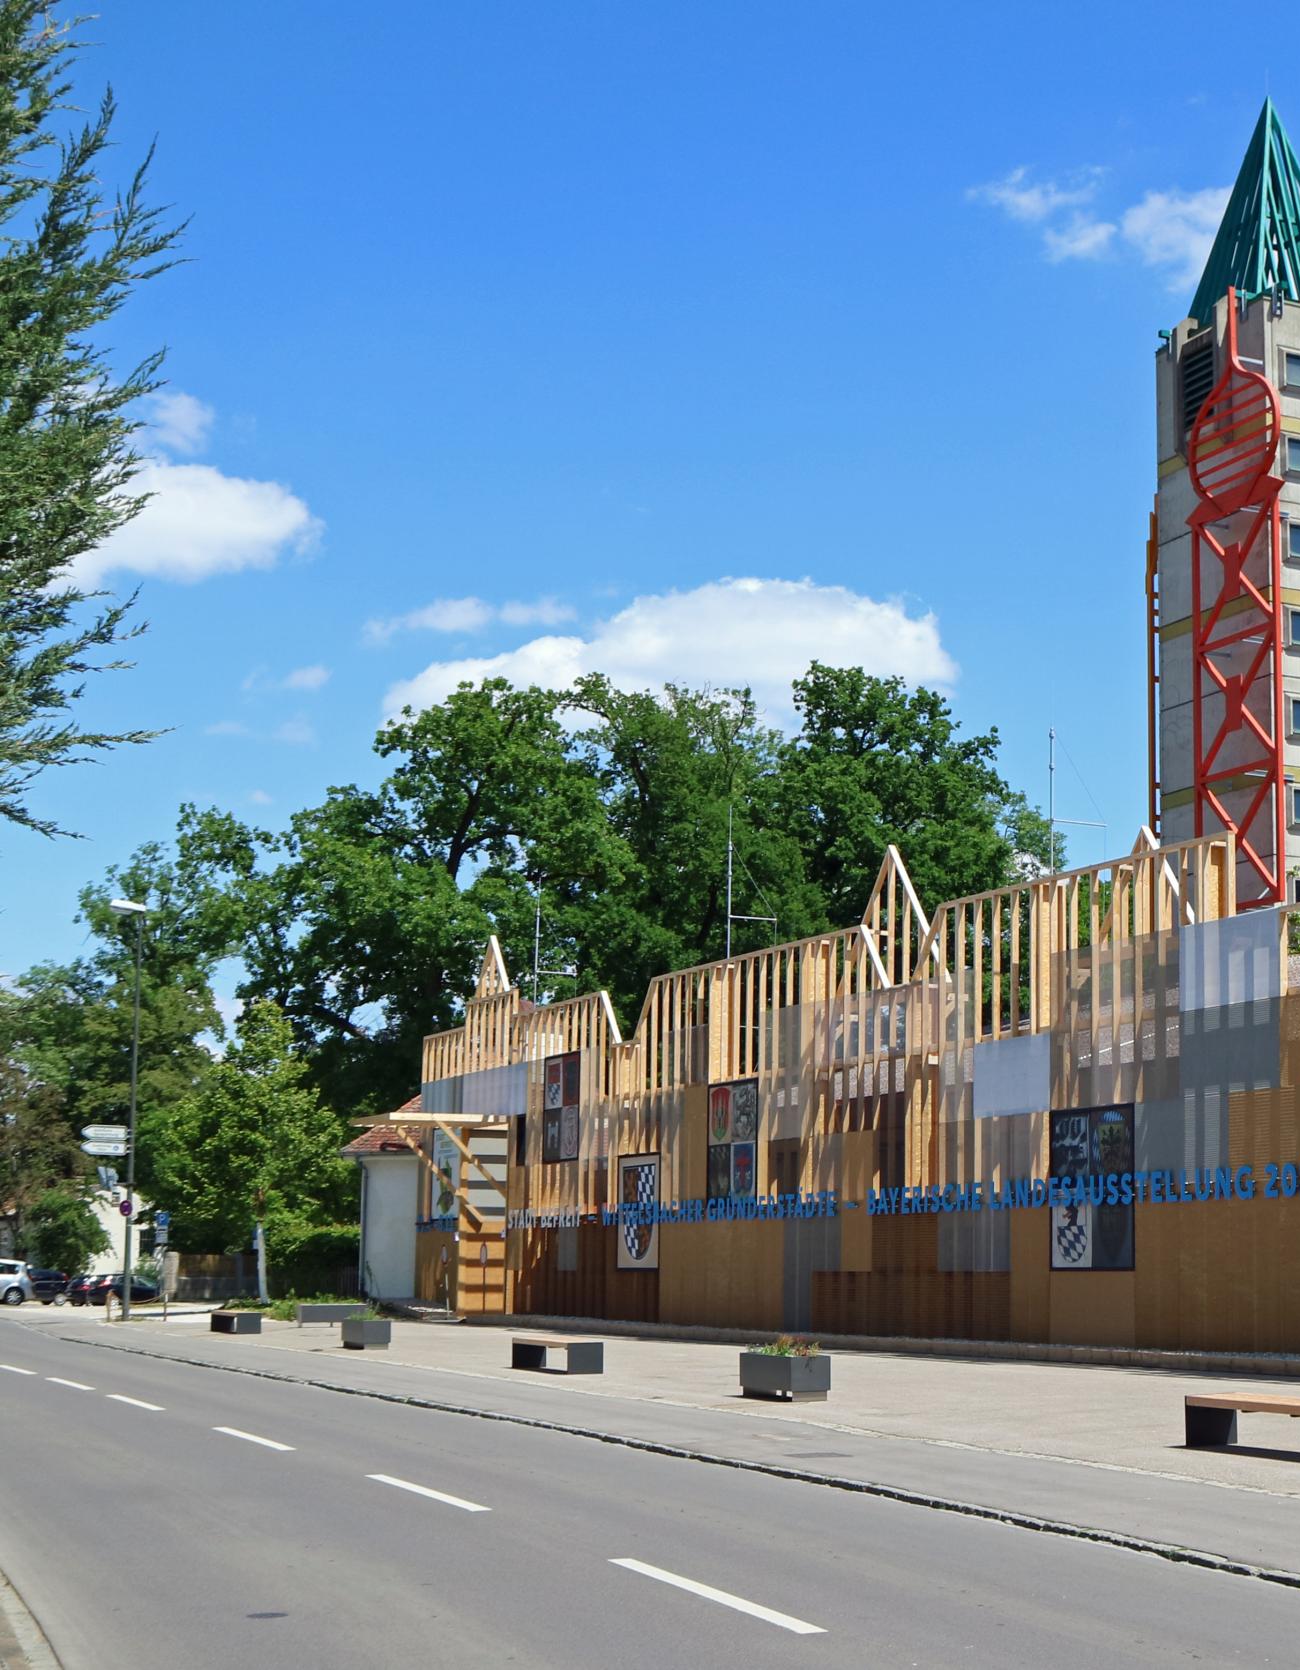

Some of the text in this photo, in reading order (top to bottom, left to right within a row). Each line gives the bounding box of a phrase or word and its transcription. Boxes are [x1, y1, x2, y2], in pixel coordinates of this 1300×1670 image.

[706, 1186, 838, 1222] GRÜNDERSTÄDTE
[866, 1181, 982, 1216] BAYERISCHE
[988, 1164, 1255, 1210] LANDESAUSSTELLUNG
